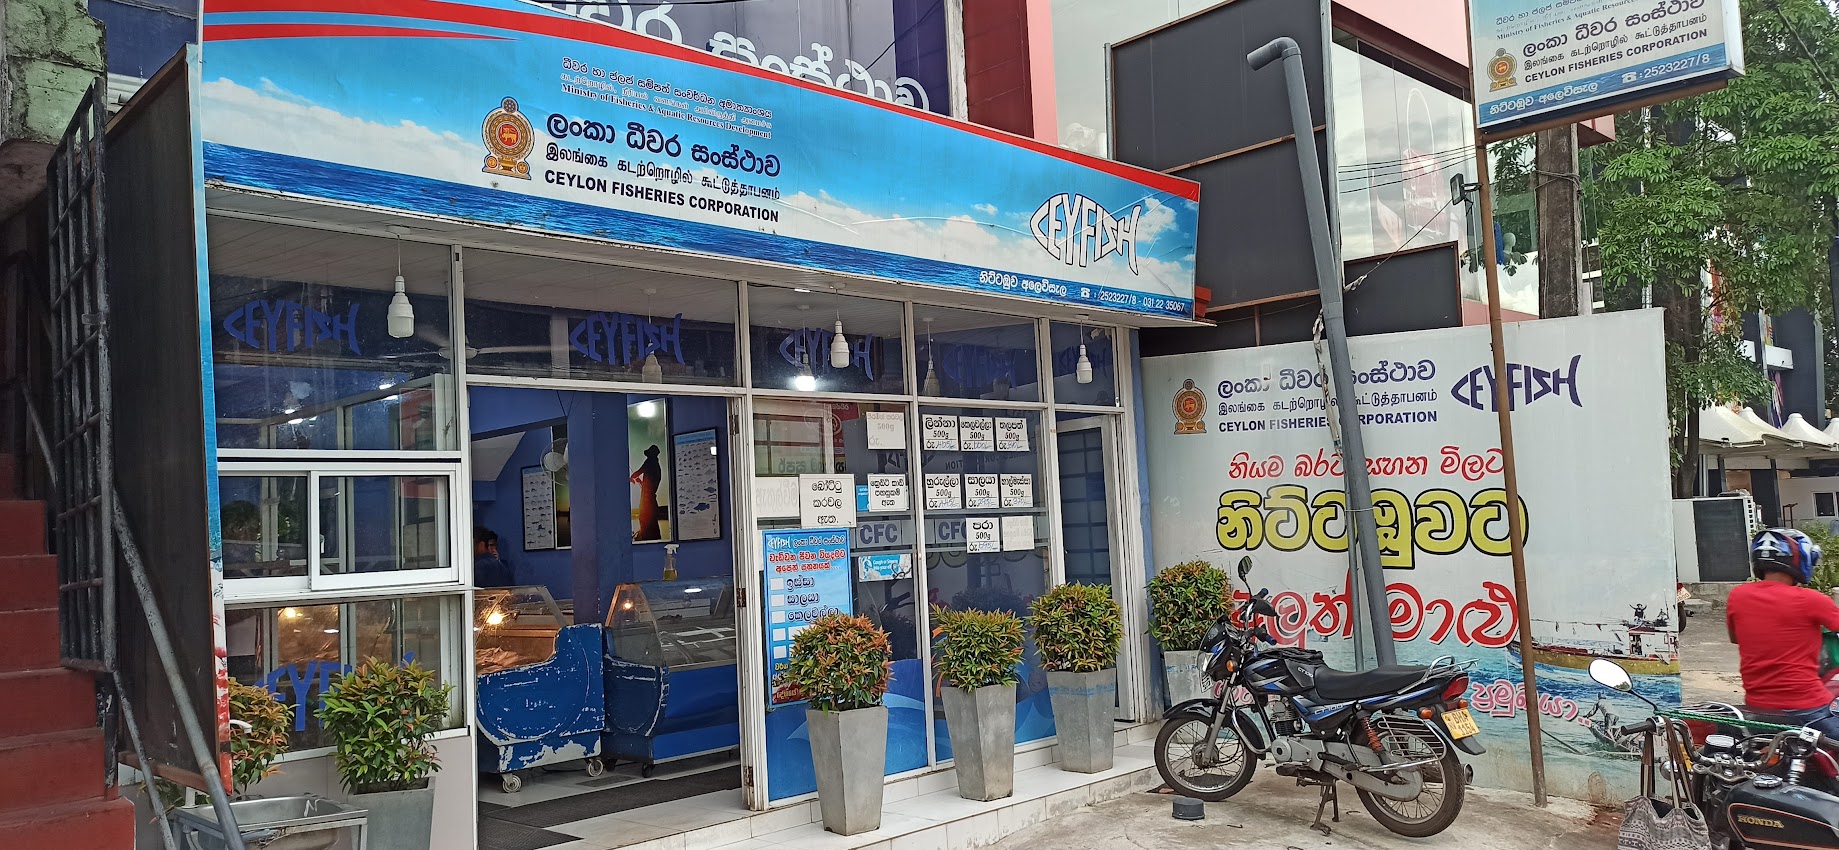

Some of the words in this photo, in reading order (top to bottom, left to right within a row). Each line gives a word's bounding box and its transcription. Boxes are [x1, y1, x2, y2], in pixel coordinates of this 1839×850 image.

[1497, 28, 1525, 40] Ministry
[1534, 18, 1565, 30] Fisheries
[1573, 7, 1600, 19] Aquatic
[1522, 34, 1568, 57] ලංකා
[1575, 17, 1618, 41] ධීවර
[1524, 53, 1565, 71] இலங்கை
[1571, 34, 1628, 57] கடற்றொழில்
[1635, 13, 1707, 40] கூட்டுத்தாபனம்
[1525, 66, 1565, 83] CEYLON
[1568, 51, 1623, 71] FISHERIES
[1626, 28, 1707, 57] CORPORATION
[563, 58, 588, 73] ධීවර
[592, 68, 605, 78] හා
[561, 83, 597, 100] Ministry
[600, 93, 609, 101] of
[610, 95, 647, 111] Fisheries
[648, 104, 655, 112] &
[657, 107, 685, 119] Aquatic
[687, 113, 724, 128] Resources
[725, 122, 771, 139] Development
[1489, 96, 1534, 115] නිට්ටඹුව
[547, 113, 616, 144] ලංකා
[626, 122, 682, 157] ධීවර
[691, 144, 781, 178] සංස්ථාව
[546, 142, 608, 168] இலங்கை
[617, 158, 693, 185] கடற்றொழில்
[701, 176, 780, 200] கூட்டுத்தாபனம்
[545, 169, 607, 193] CEYLON
[612, 181, 685, 206] FISHERIES
[689, 195, 779, 222] CORPORATION
[1029, 192, 1142, 276] CEYFISH
[979, 271, 1018, 289] නිට්ටඹුව
[1021, 279, 1067, 297] අලෙවිසැල
[1165, 301, 1185, 312] 35067
[223, 300, 361, 355] CEYFISH
[569, 312, 685, 365] CEYFISH
[779, 327, 874, 381] CEYFH
[1218, 377, 1270, 398] ලංකා
[1280, 369, 1329, 390] ධීවර
[1450, 355, 1583, 412] CEYFISH
[1218, 403, 1265, 415] இலங்கை
[925, 417, 956, 429] ලින්නා
[1000, 420, 1023, 431] තලපත්
[1219, 420, 1266, 433] CEYLON
[1359, 411, 1437, 425] RPORATION
[933, 430, 949, 439] 500g
[970, 432, 985, 440] 500g
[1005, 433, 1019, 441] 500g
[1228, 452, 1284, 479] නියම
[1294, 449, 1345, 477] බරට
[1366, 454, 1428, 475] සහන
[1440, 445, 1505, 481] මිලට
[812, 480, 842, 493] බෝට්ටු
[927, 476, 959, 488] හුරුල්ලා
[968, 476, 995, 487] සාලයා
[813, 497, 842, 509] කරවල
[881, 499, 895, 507] ඇත
[936, 489, 952, 498] 500g
[975, 489, 990, 498] 500g
[1010, 489, 1024, 497] 500g
[860, 523, 898, 544] CFC
[972, 520, 993, 530] පරා
[1216, 484, 1529, 570] නිට්ටඹුවට
[976, 532, 991, 540] 500g
[787, 593, 819, 606] සාලයා
[1385, 582, 1519, 648] මාළු
[1737, 814, 1785, 829] HONDA
